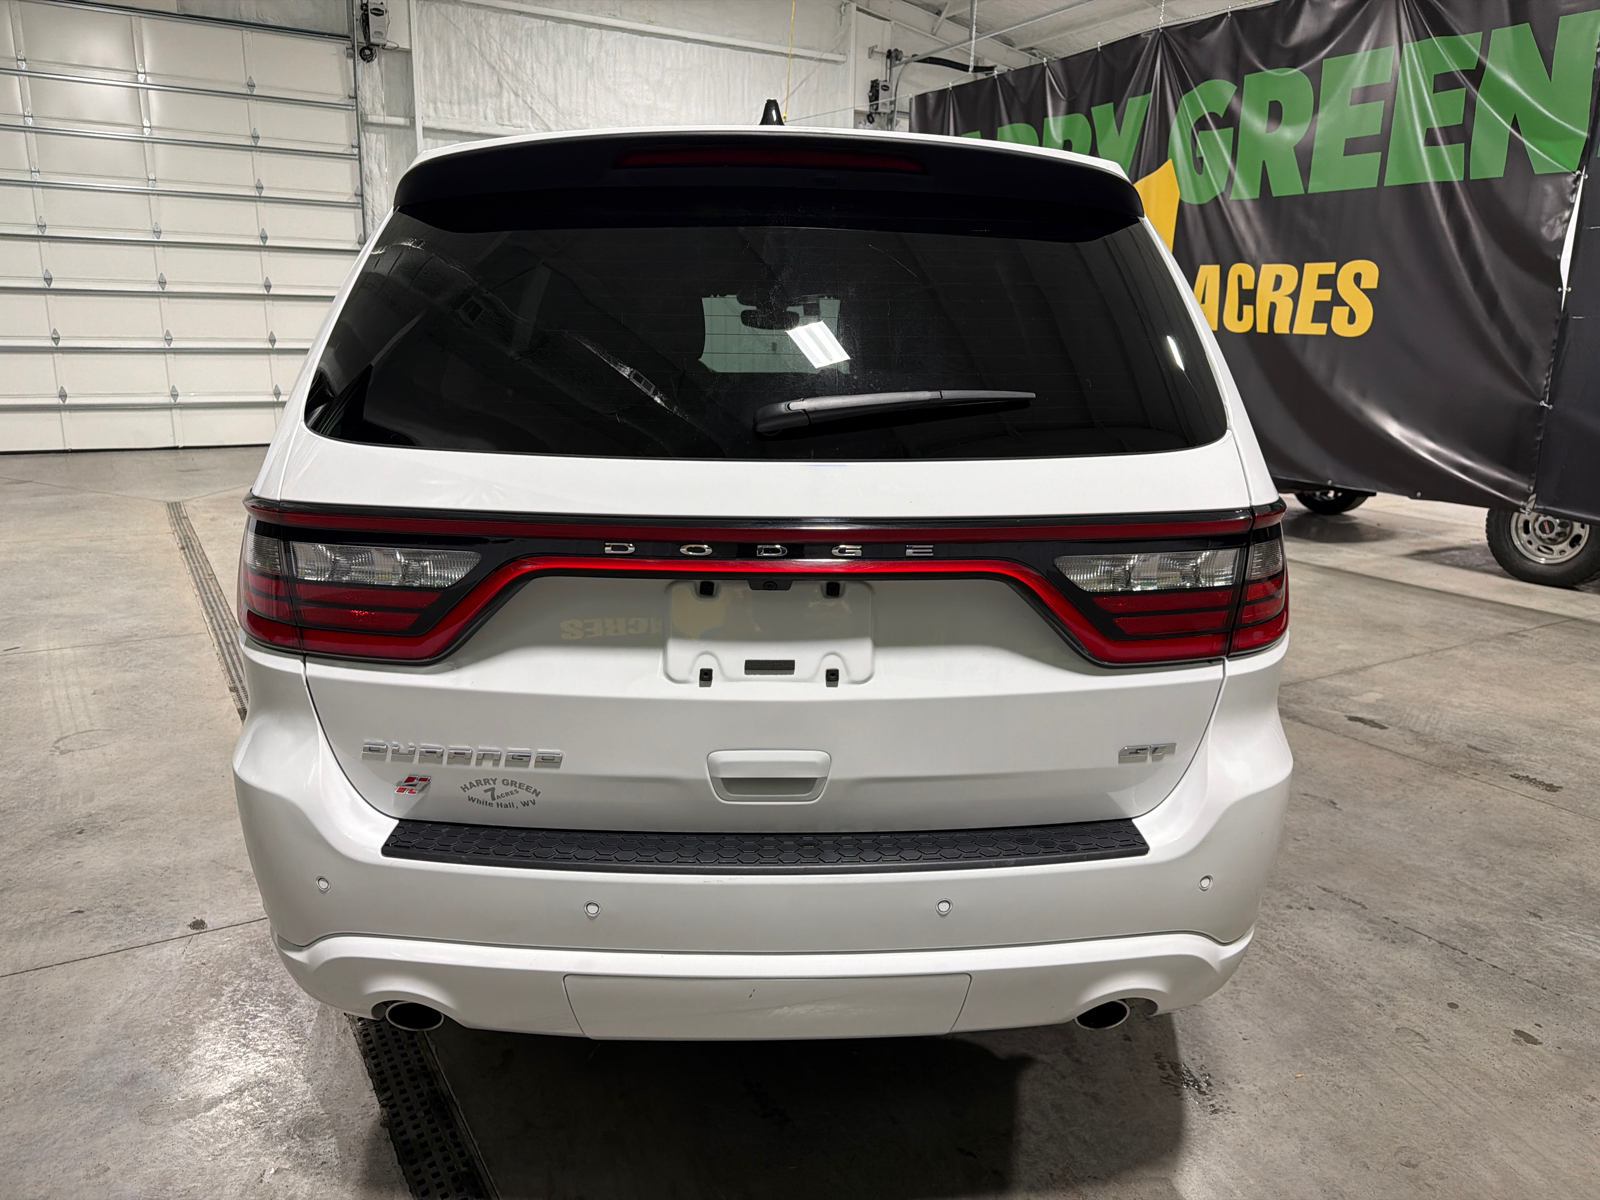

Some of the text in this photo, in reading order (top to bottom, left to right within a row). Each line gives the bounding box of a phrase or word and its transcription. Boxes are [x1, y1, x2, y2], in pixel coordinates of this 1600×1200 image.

[1168, 9, 1600, 204] GREEN
[1193, 260, 1379, 337] ACRES
[604, 542, 934, 557] DODGE
[362, 741, 564, 768] DURANGO
[460, 778, 541, 797] HARRY GREEN
[483, 787, 519, 801] 7 ACRES
[468, 795, 493, 808] White
[520, 799, 536, 807] WV
